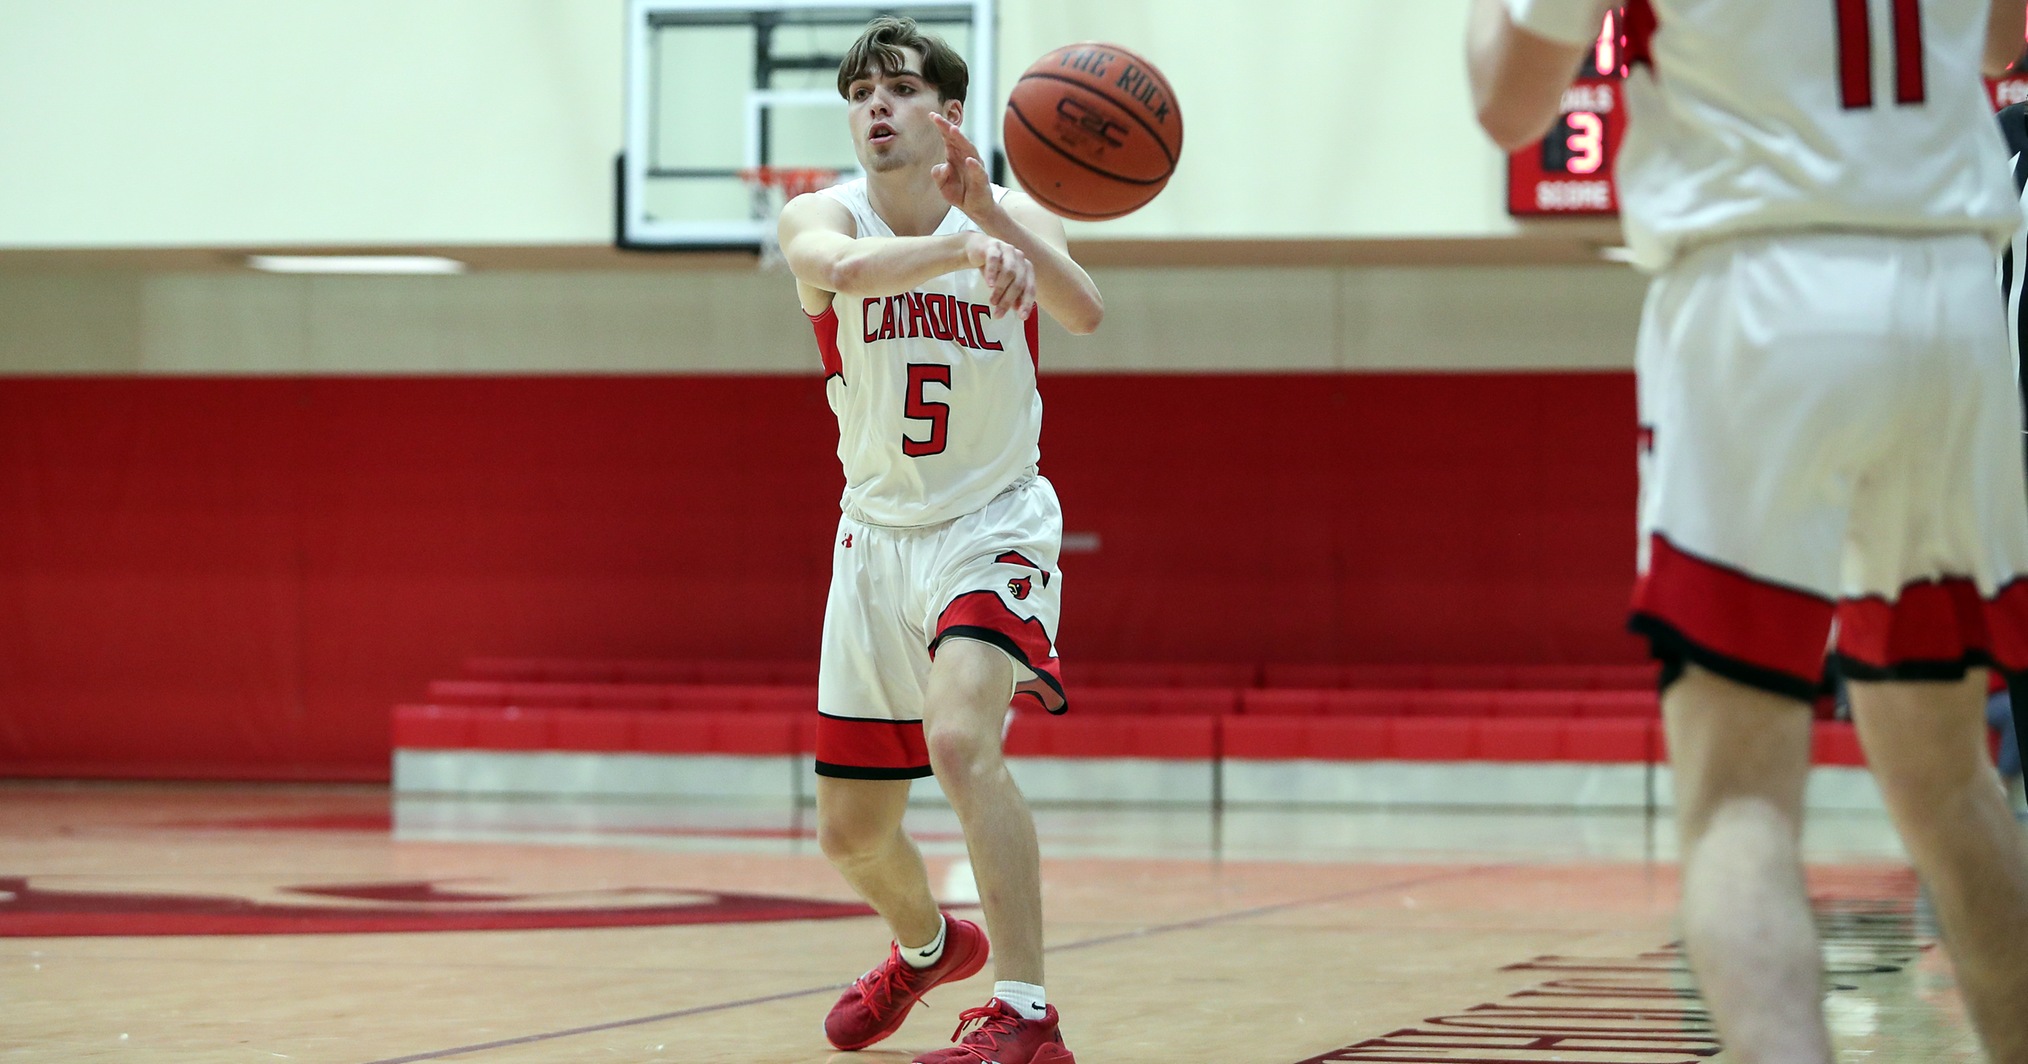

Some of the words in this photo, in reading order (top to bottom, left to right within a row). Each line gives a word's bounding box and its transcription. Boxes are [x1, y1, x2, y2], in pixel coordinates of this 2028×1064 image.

[1059, 50, 1114, 78] THE
[1115, 63, 1171, 125] ROCK
[1832, 0, 1926, 110] 11
[1566, 111, 1603, 174] 3
[1536, 180, 1611, 210] SCORE
[863, 290, 1005, 352] CATHOLIC
[902, 362, 952, 458] 5
